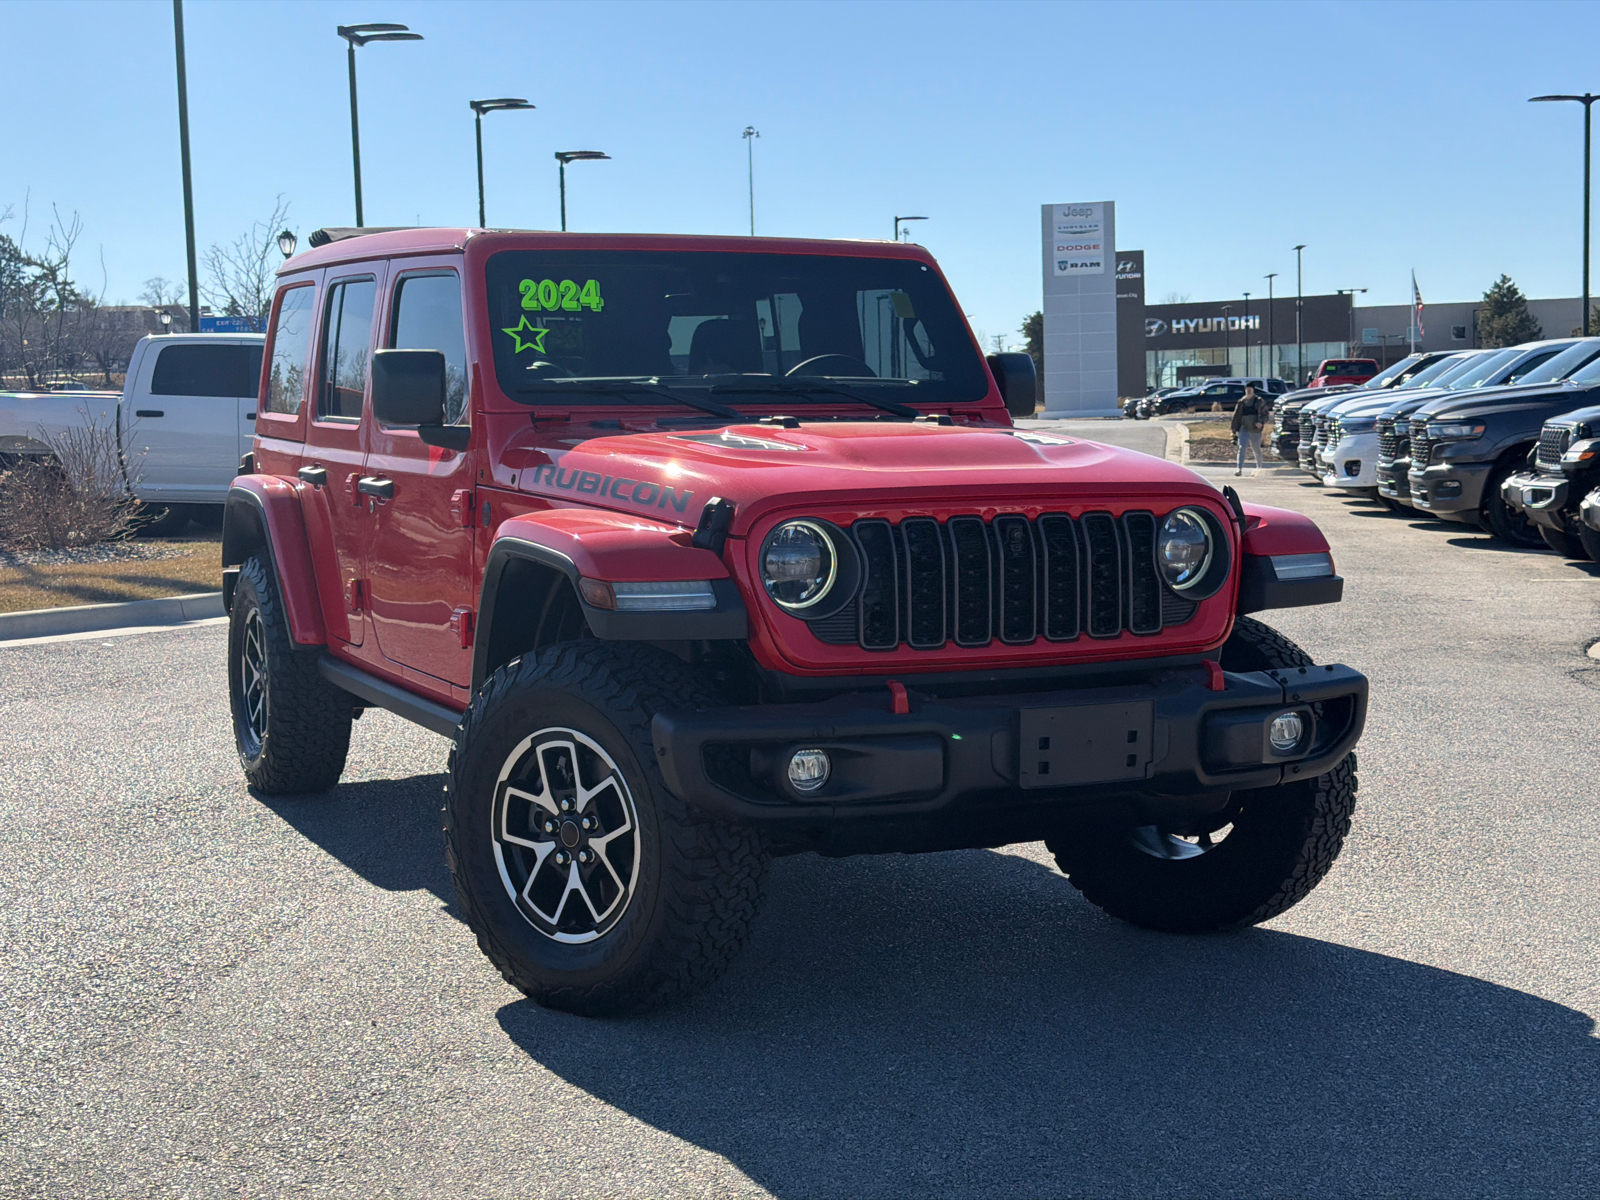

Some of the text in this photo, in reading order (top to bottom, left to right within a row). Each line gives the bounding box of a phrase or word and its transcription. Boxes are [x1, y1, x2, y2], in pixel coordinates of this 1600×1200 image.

[1063, 206, 1093, 218] Jeep
[519, 279, 604, 312] 2024
[1172, 315, 1260, 334] HYUNDAI
[533, 464, 694, 514] RUBICON
